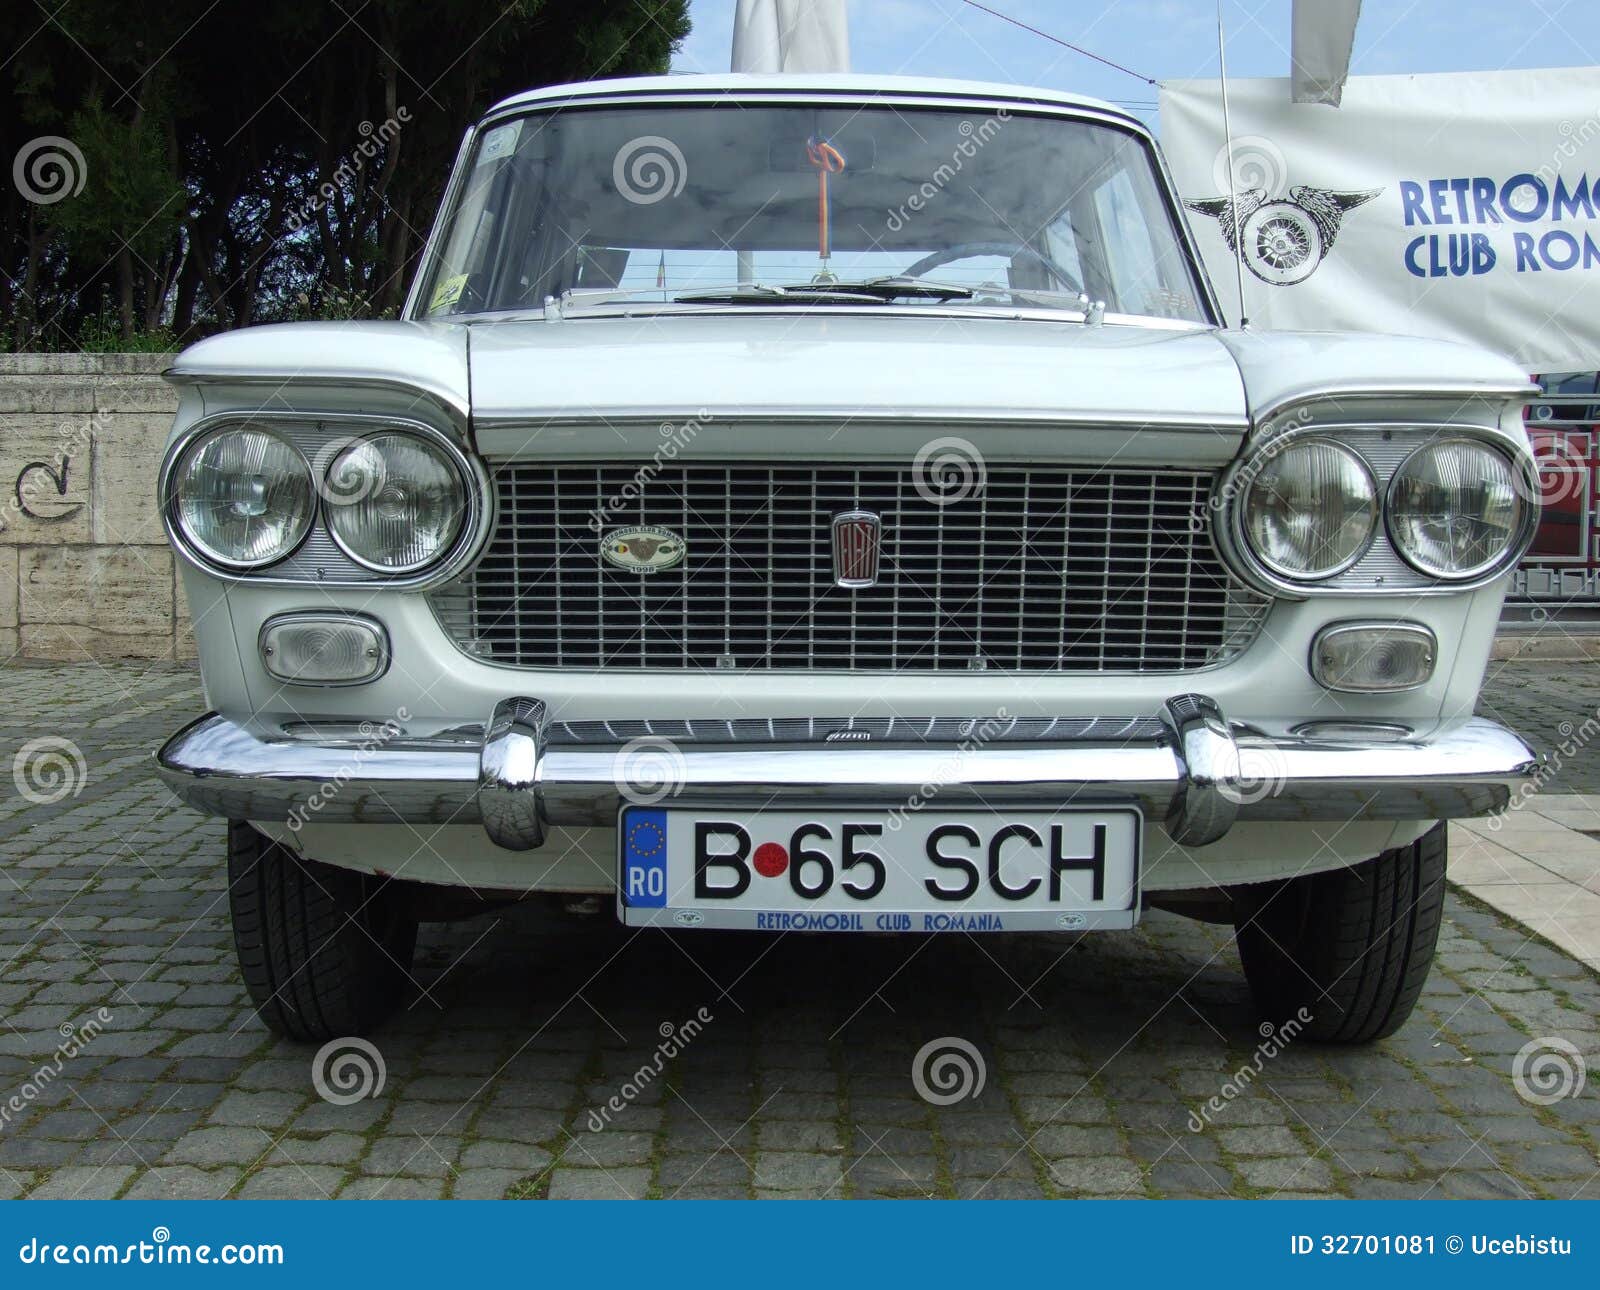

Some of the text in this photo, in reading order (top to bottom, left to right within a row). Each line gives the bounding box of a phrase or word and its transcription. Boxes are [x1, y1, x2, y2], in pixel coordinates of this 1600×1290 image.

[1400, 172, 1600, 226] RETROM
[1404, 232, 1497, 278] CLUB
[630, 866, 664, 897] RO
[695, 821, 1107, 901] B 65 SCH
[757, 912, 1004, 930] RETROMOBIL CLUB ROMANIA
